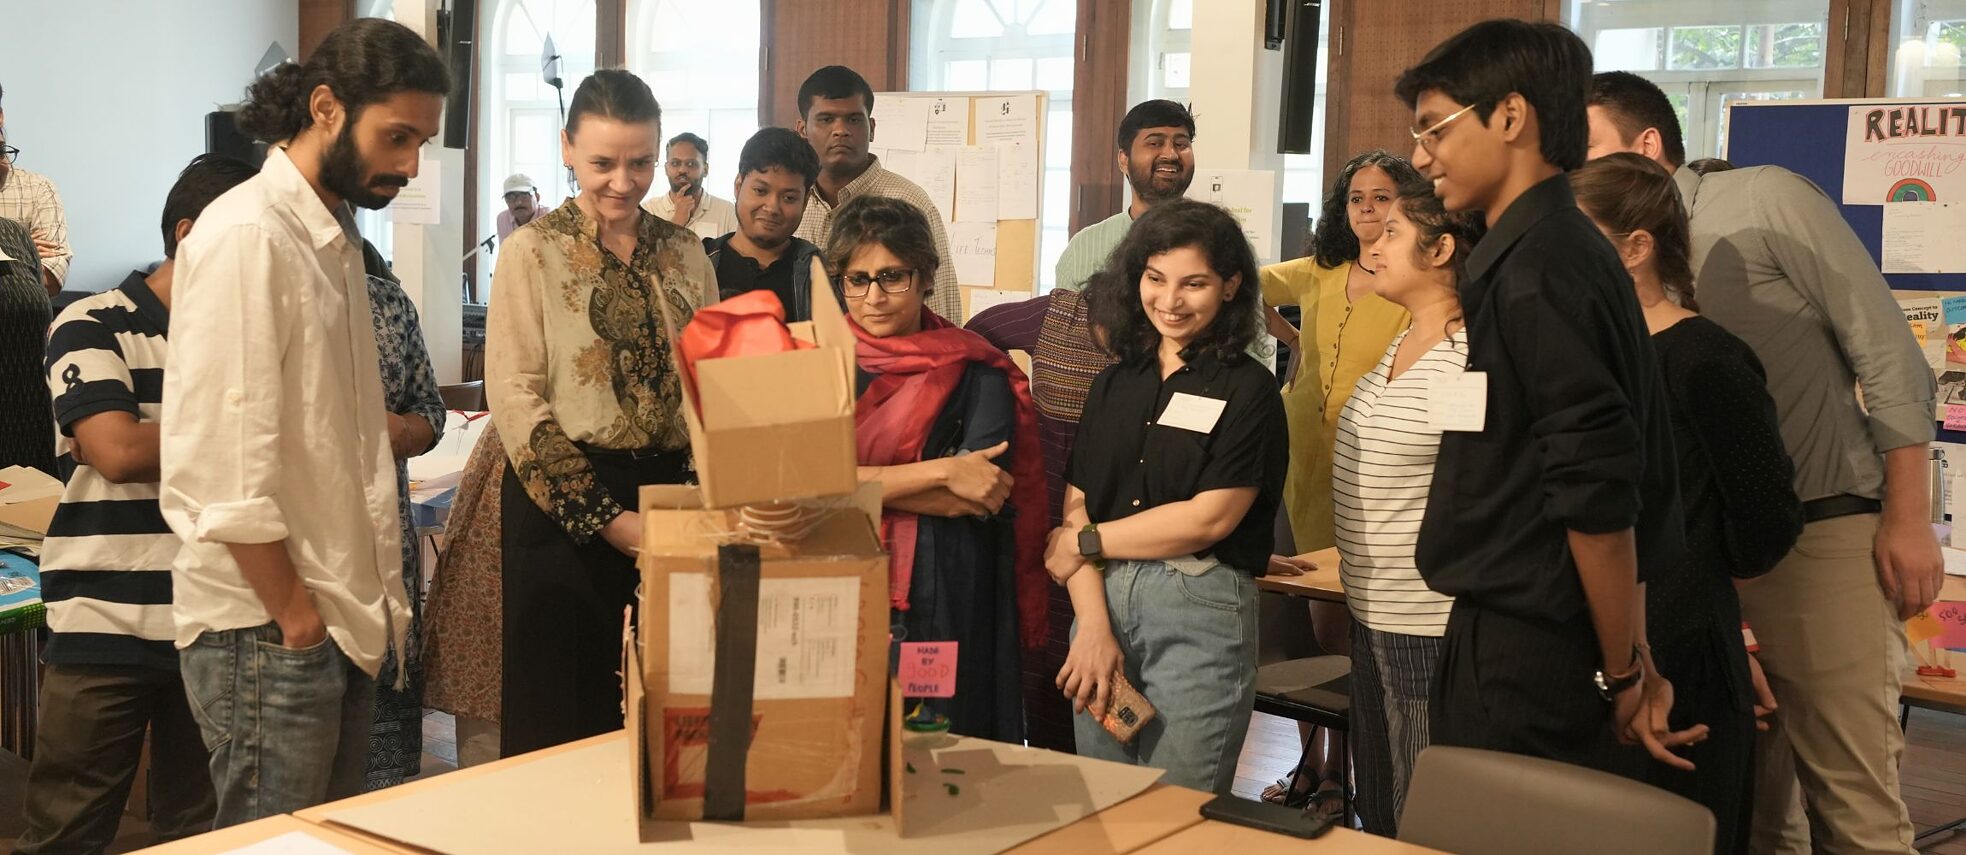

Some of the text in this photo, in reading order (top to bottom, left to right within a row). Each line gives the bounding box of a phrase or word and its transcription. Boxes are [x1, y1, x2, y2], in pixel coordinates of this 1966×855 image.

[1884, 160, 1941, 178] GOODWILL
[1906, 311, 1939, 322] eality
[921, 657, 935, 666] BY
[908, 682, 939, 693] PEOPLE
